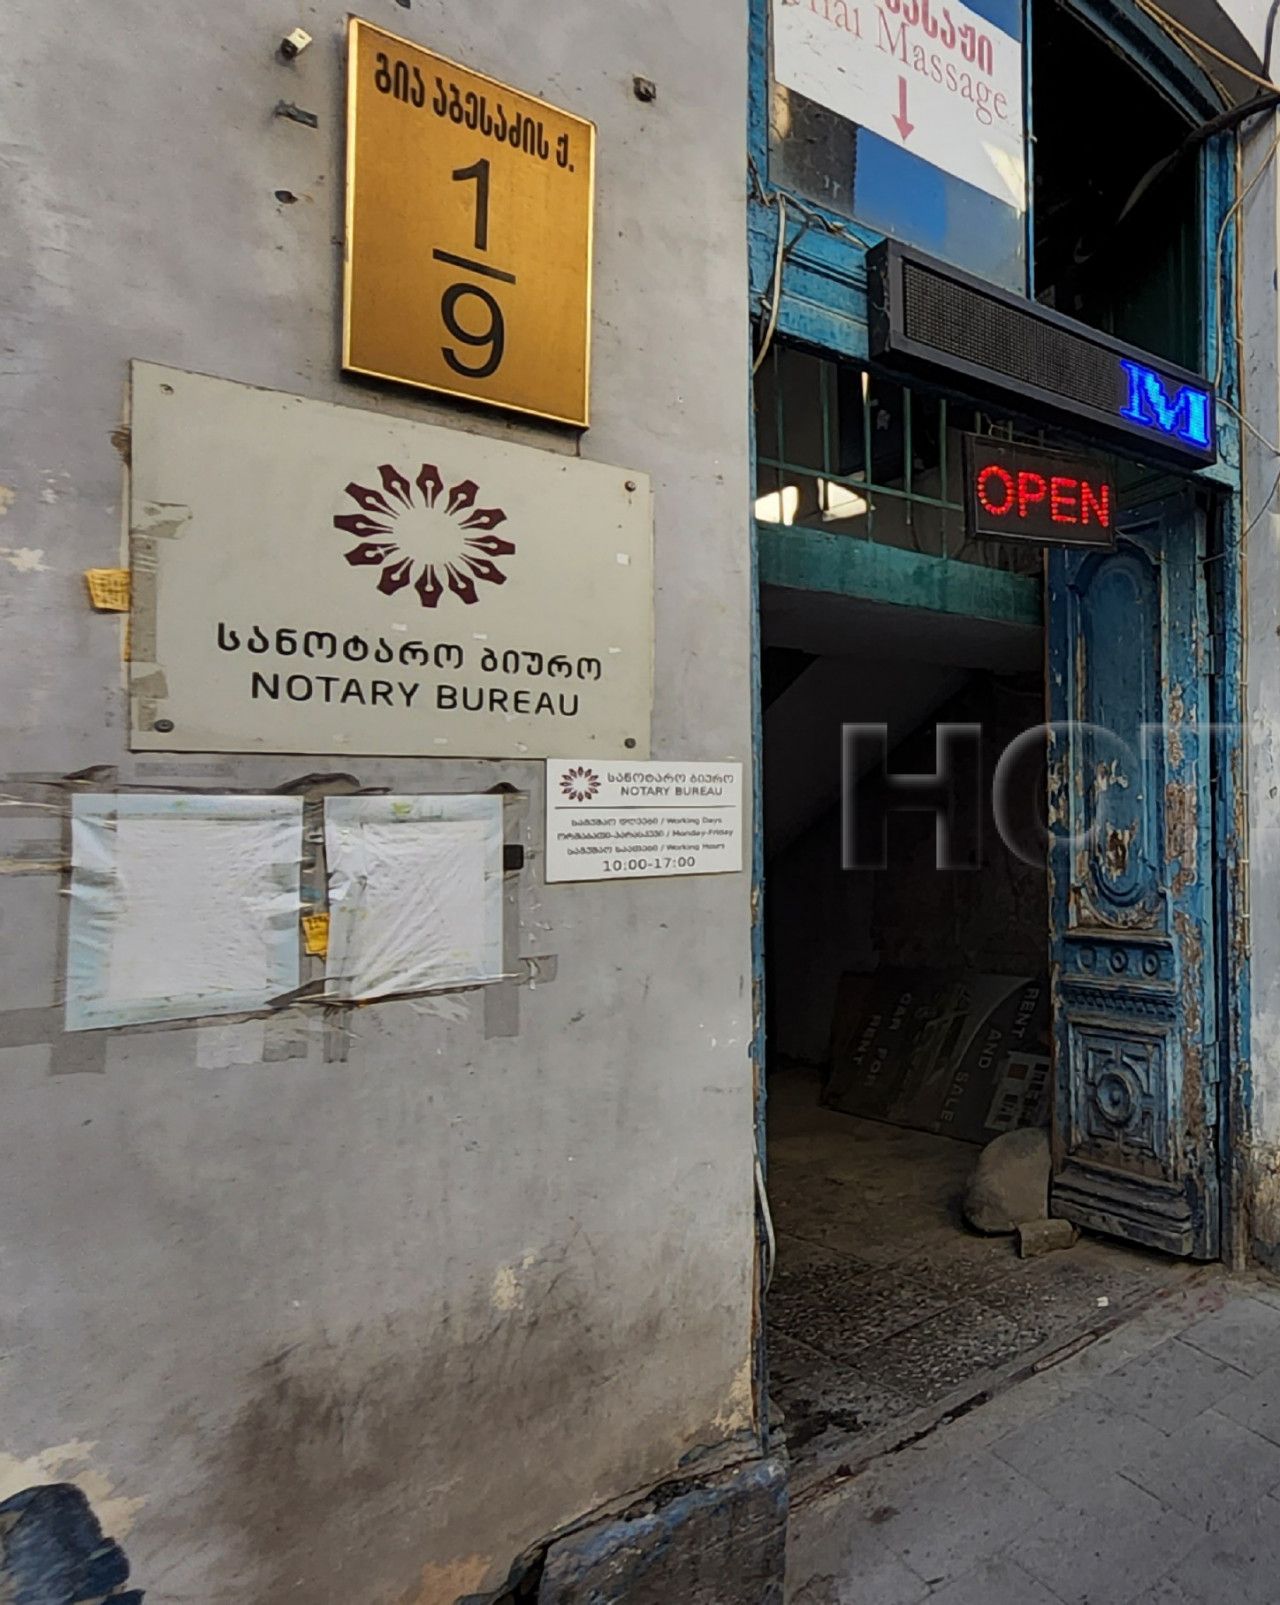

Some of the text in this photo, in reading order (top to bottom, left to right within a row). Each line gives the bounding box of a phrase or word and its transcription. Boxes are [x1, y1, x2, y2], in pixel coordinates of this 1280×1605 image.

[874, 4, 1008, 126] Massage
[884, 0, 994, 76] ასაჟი
[374, 52, 426, 108] გია
[432, 76, 549, 160] აბესაძის
[451, 158, 490, 252] 1
[440, 282, 506, 378] 9
[976, 464, 1110, 528] OPEN
[217, 622, 602, 681] სანოტარო ბიურო
[251, 671, 579, 716] NOTARY BUREAU
[607, 772, 734, 784] სანოტარო ბიურო
[620, 786, 723, 797] NOTARY BUREAU
[666, 817, 700, 827] Working
[701, 816, 723, 827] Days
[666, 844, 700, 853] Working
[602, 856, 696, 873] 10:00-17:00
